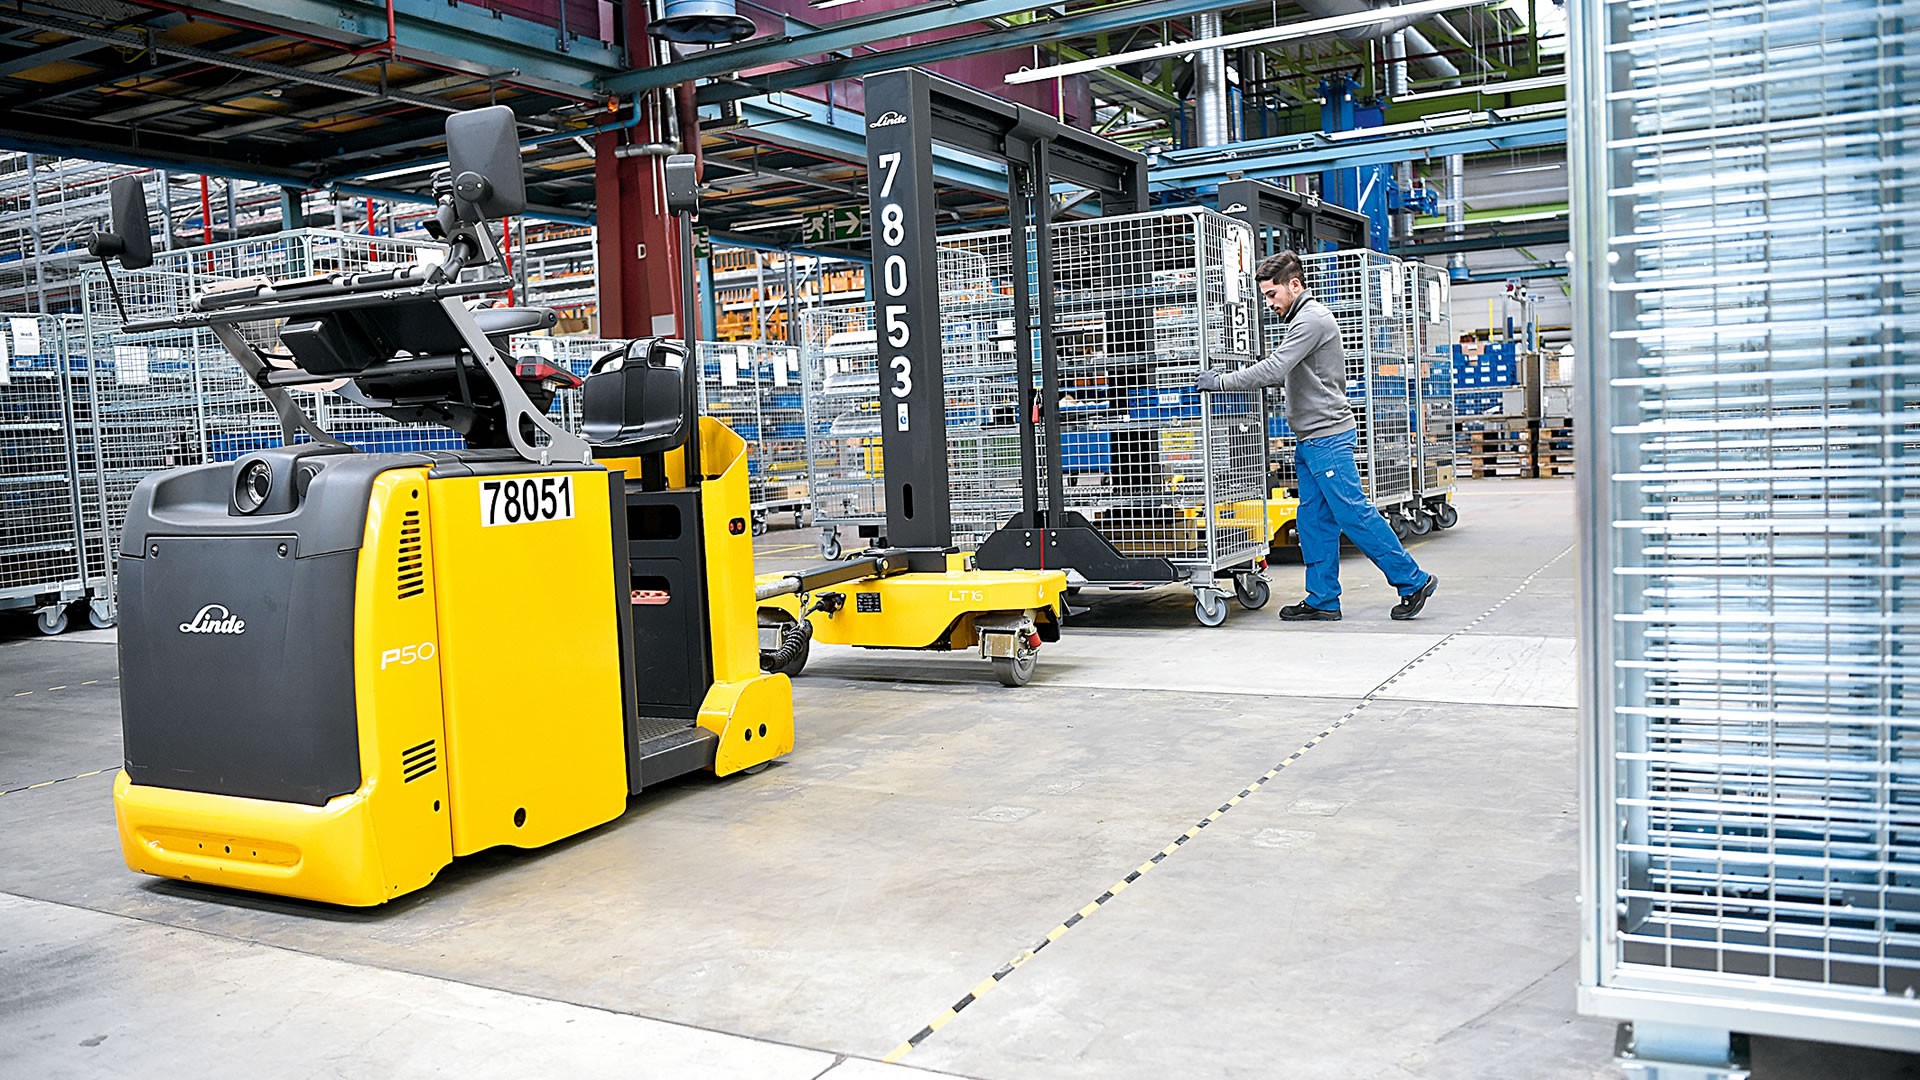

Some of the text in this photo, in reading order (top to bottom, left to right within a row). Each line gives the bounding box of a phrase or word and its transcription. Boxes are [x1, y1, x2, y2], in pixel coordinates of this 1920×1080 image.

[869, 111, 908, 128] Linde
[637, 243, 647, 259] D
[879, 152, 912, 398] 78053
[483, 477, 571, 525] 78051
[179, 604, 246, 634] Linde
[380, 641, 435, 670] P50
